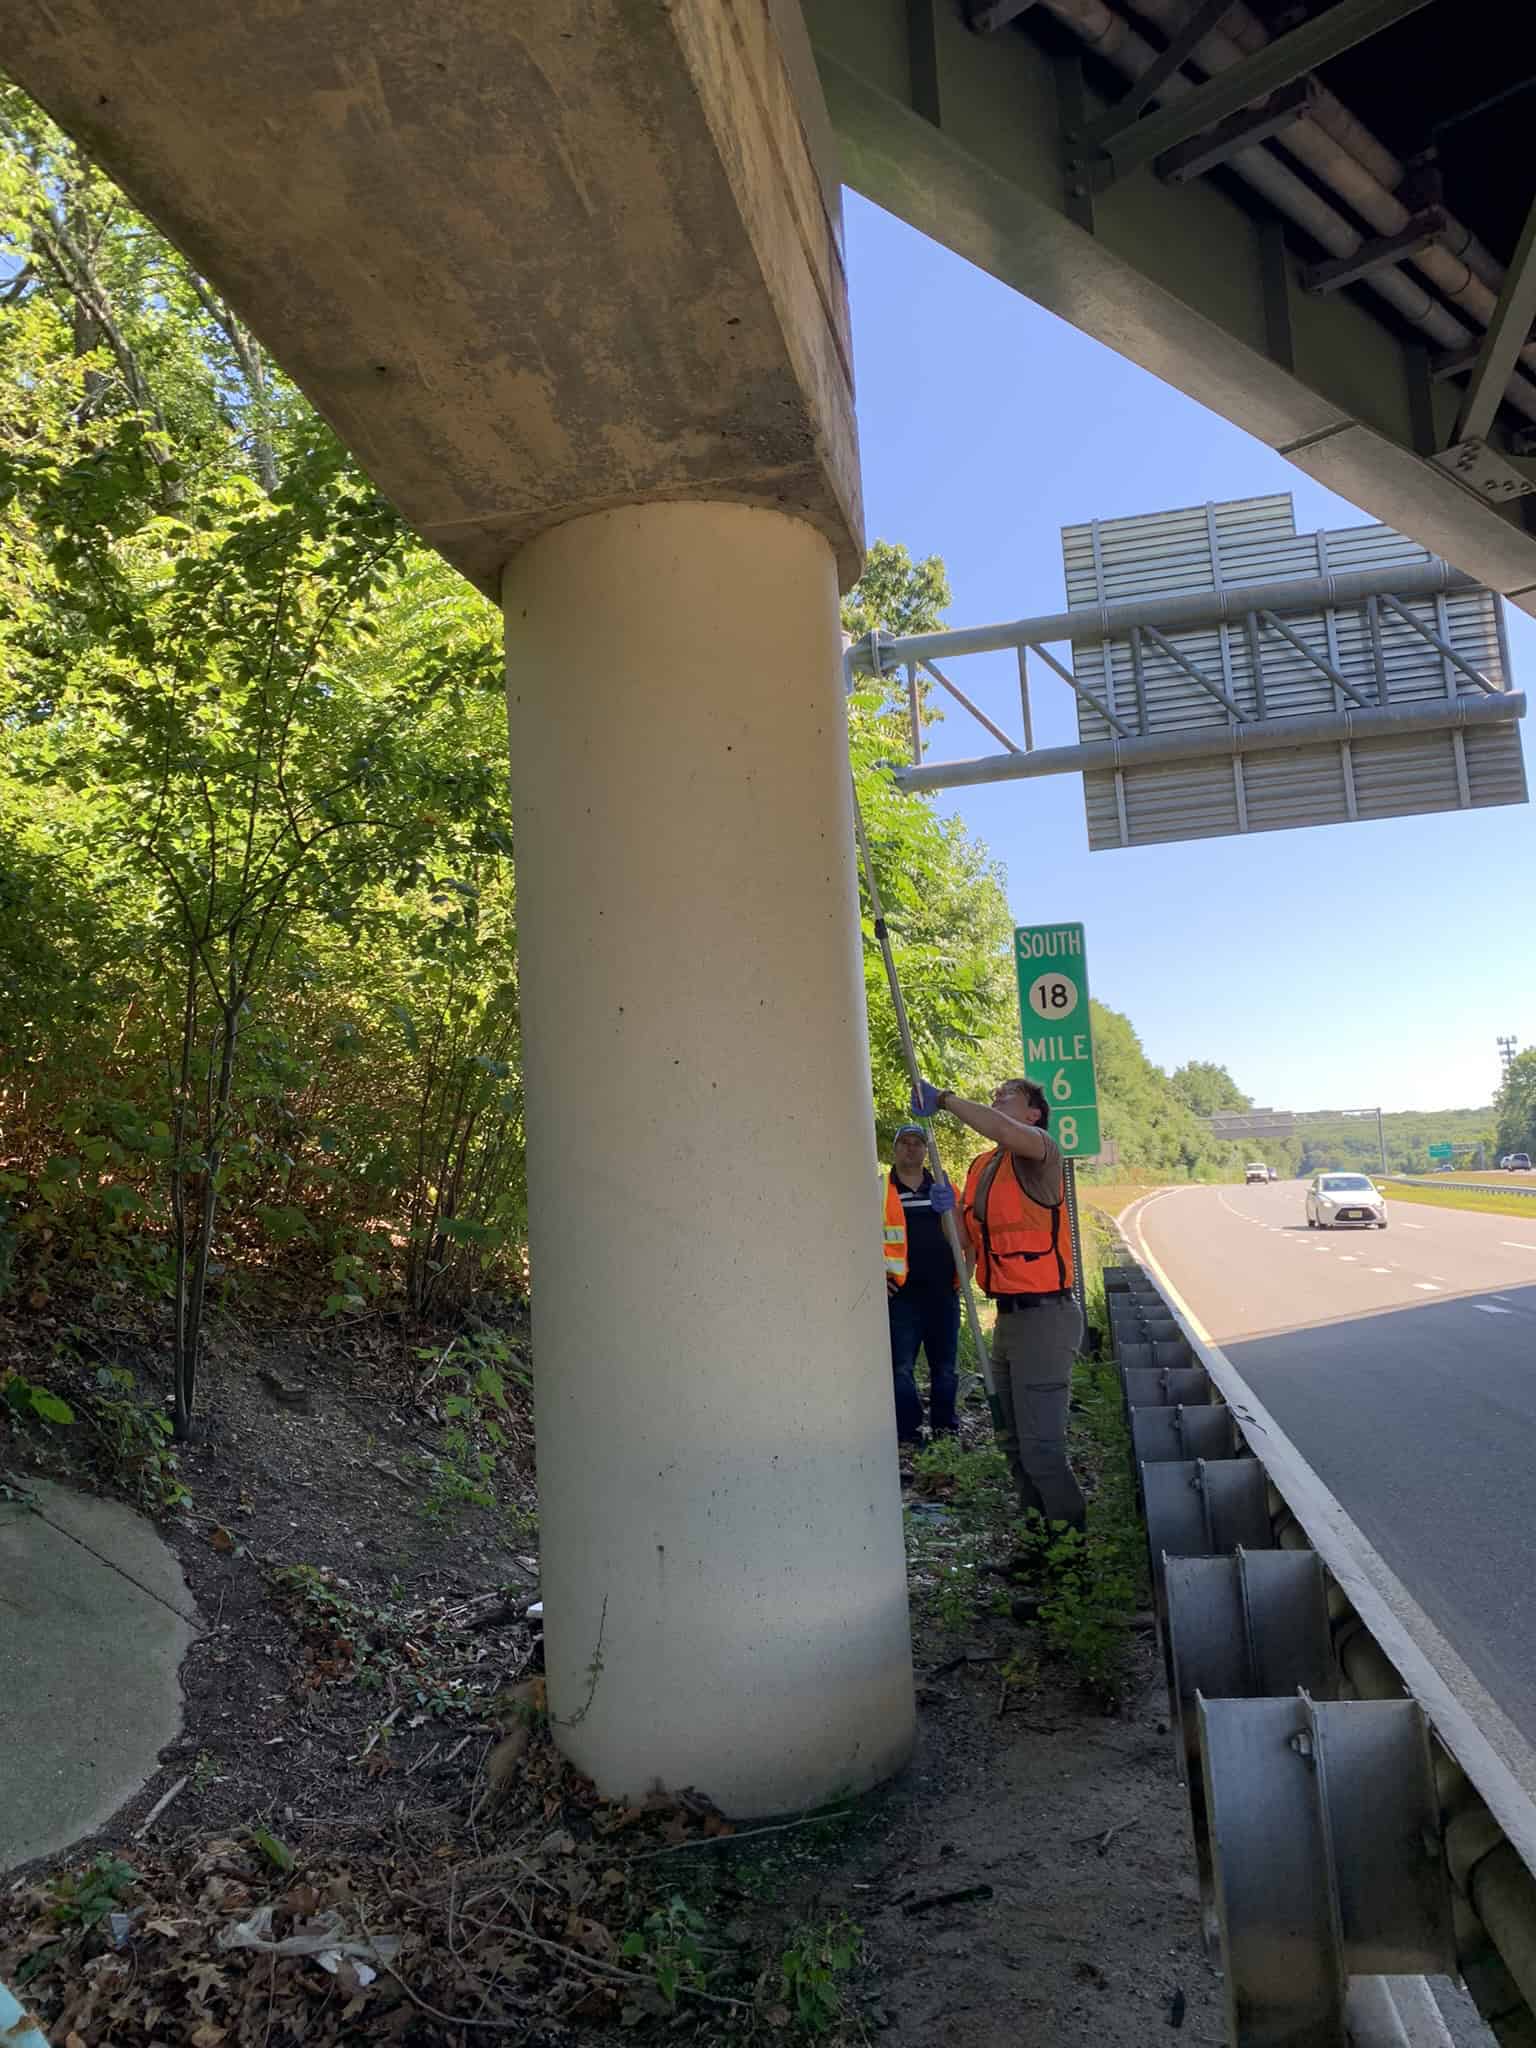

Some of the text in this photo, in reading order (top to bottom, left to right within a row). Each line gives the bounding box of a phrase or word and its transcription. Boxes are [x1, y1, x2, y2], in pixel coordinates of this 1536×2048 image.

[1019, 929, 1081, 959] SOUTH
[1038, 983, 1068, 1009] 18
[1028, 1035, 1089, 1063] MILE
[1052, 1068, 1072, 1101] 6
[1058, 1116, 1079, 1150] 8
